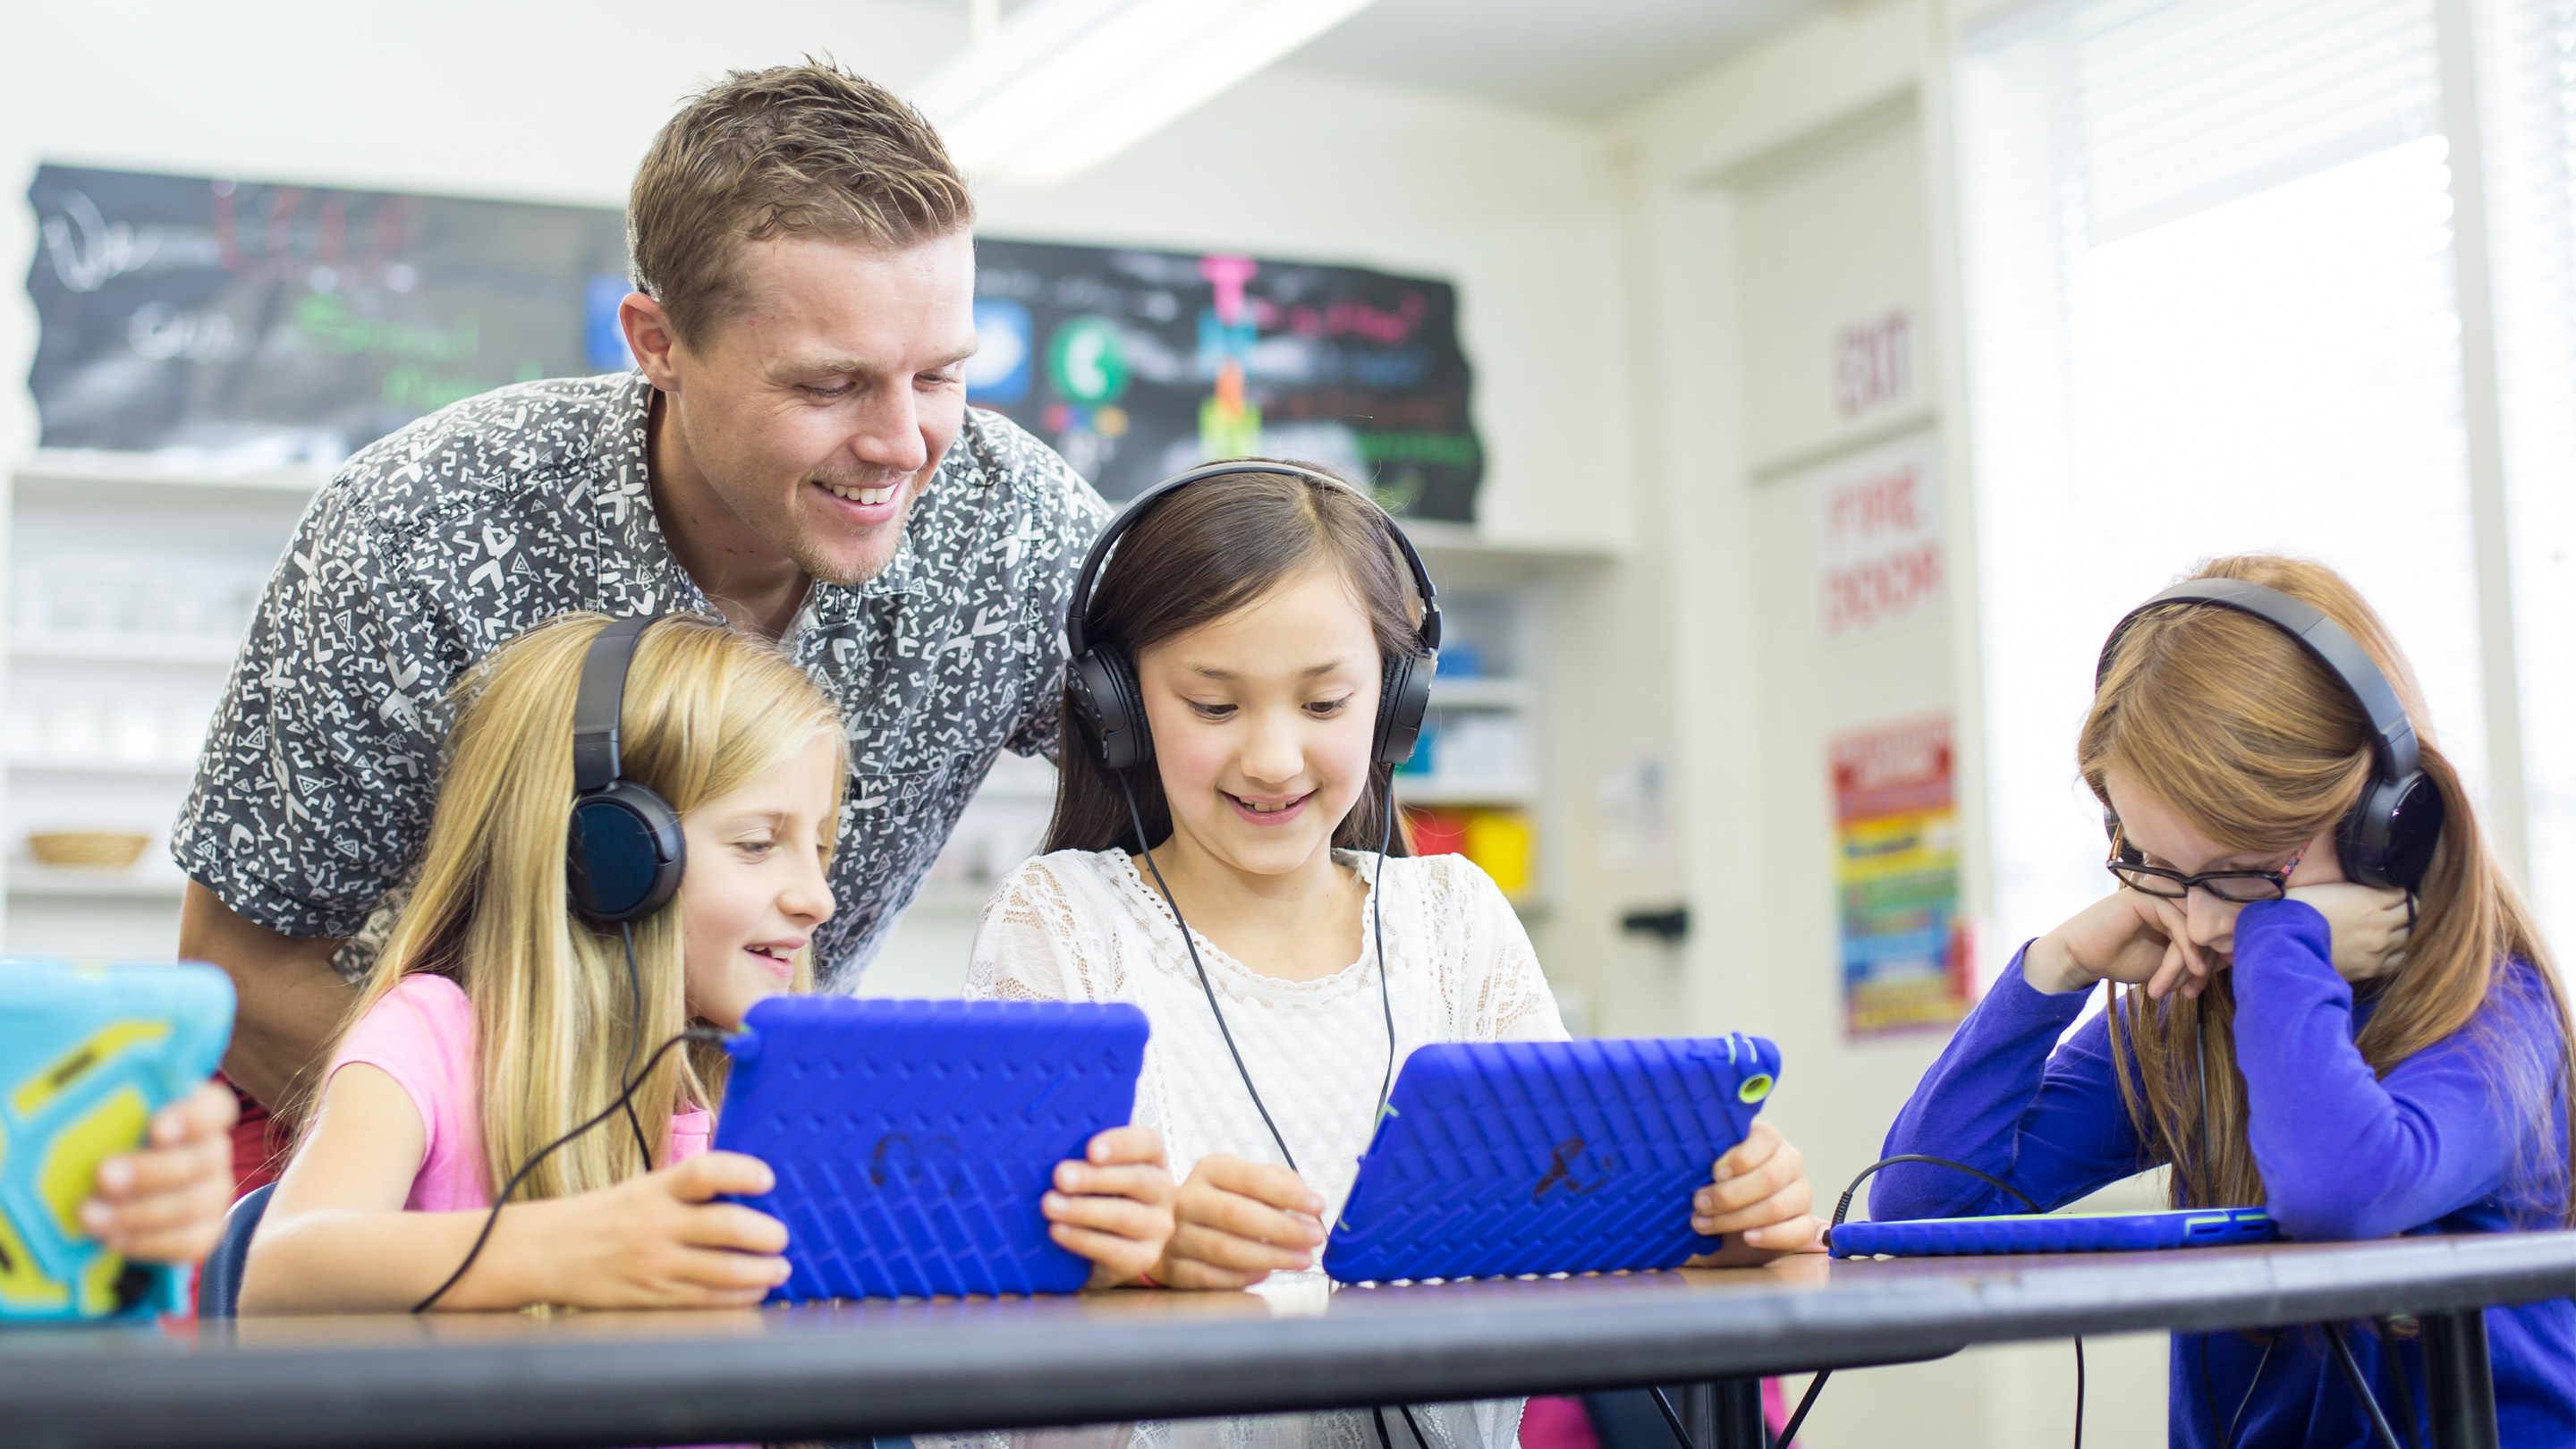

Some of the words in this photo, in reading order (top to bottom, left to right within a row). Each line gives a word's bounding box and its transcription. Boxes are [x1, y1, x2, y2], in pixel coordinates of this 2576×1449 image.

[1836, 310, 1912, 416] EXIT
[1826, 467, 1923, 542] FIRE
[1824, 544, 1945, 635] DOOR
